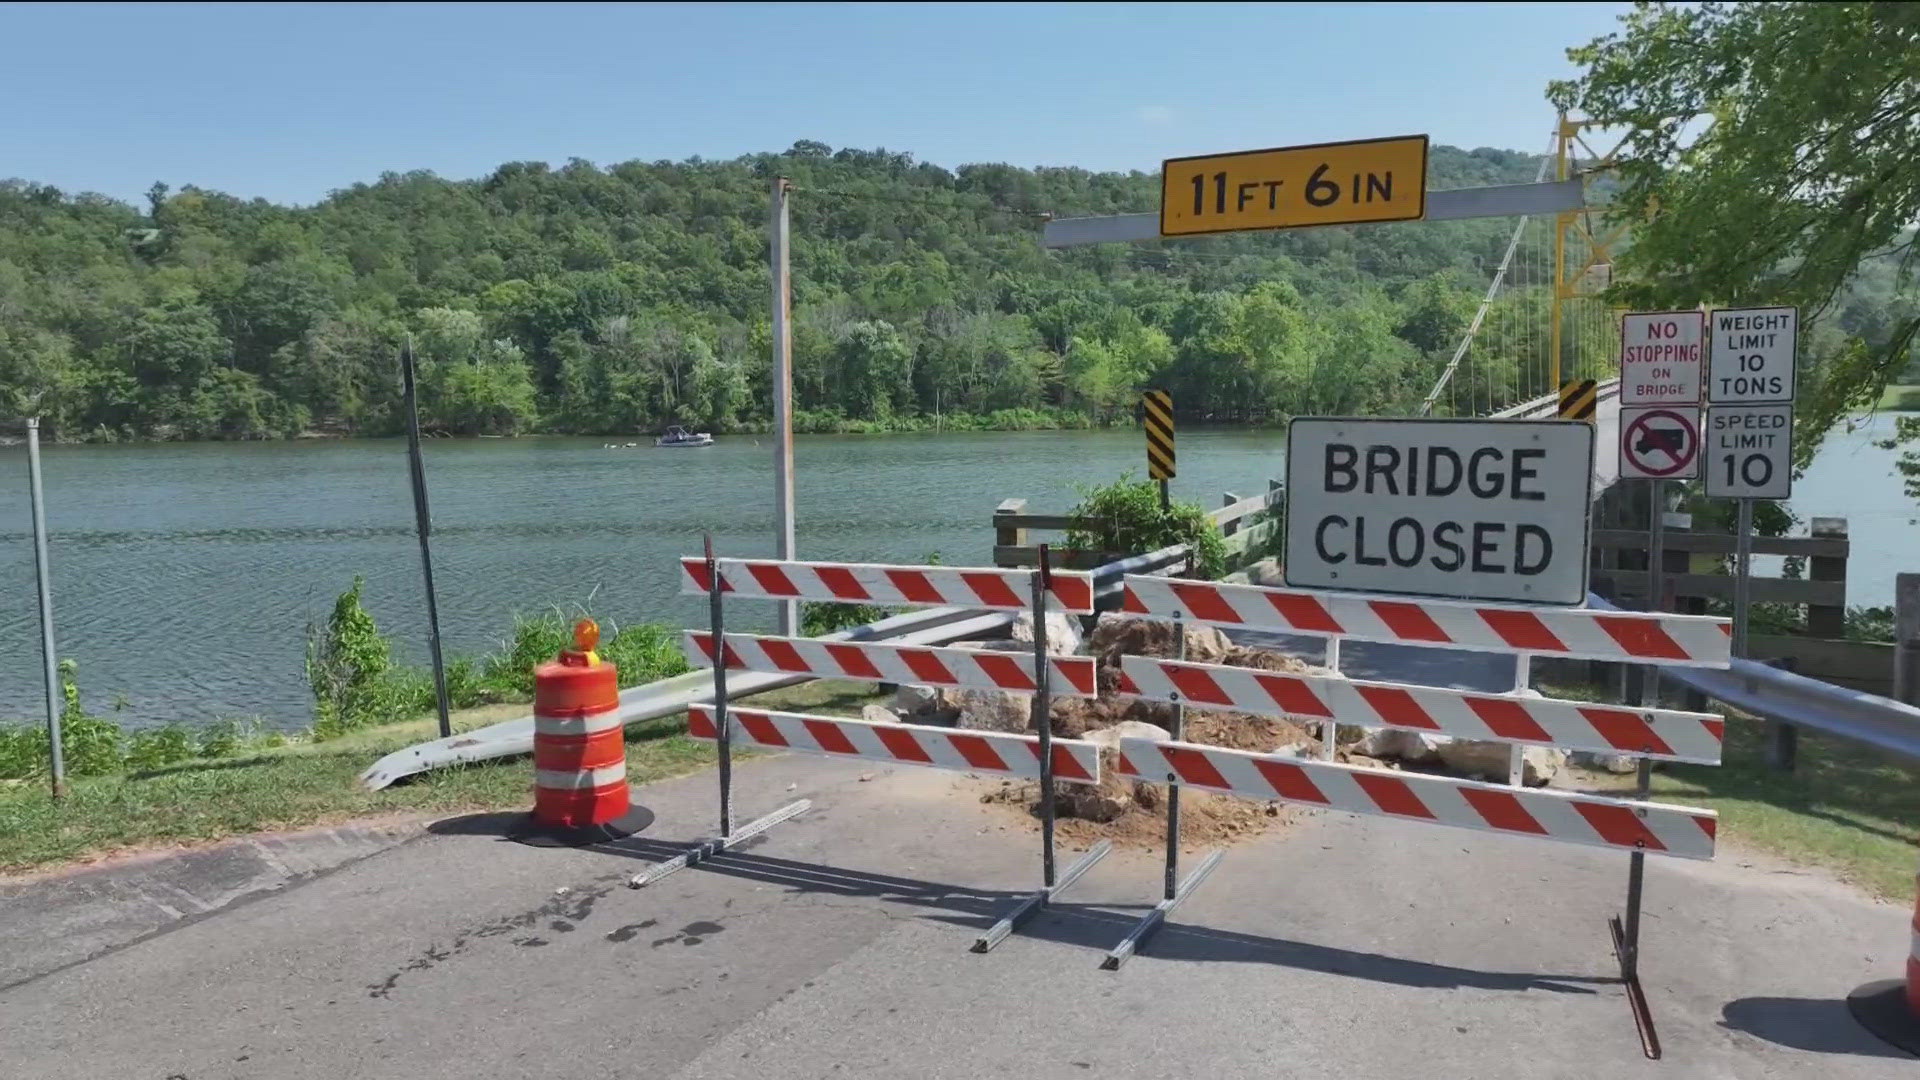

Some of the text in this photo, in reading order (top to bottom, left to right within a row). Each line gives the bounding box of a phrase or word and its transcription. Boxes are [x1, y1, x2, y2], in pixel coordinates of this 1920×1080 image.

[1192, 163, 1392, 216] 11 FT 6 IN
[1648, 322, 1678, 339] NO
[1720, 315, 1790, 331] WEIGHT
[1728, 334, 1777, 350] LIMIT
[1626, 344, 1698, 363] STOPPING
[1739, 354, 1764, 372] 10
[1652, 368, 1671, 379] ON
[1636, 384, 1686, 396] BRIDGE
[1720, 376, 1782, 395] TONS
[1714, 414, 1785, 430] SPEED
[1721, 434, 1776, 448] LIMIT
[1324, 443, 1546, 501] BRIDGE
[1723, 453, 1773, 487] 10
[1315, 514, 1553, 576] CLOSED
